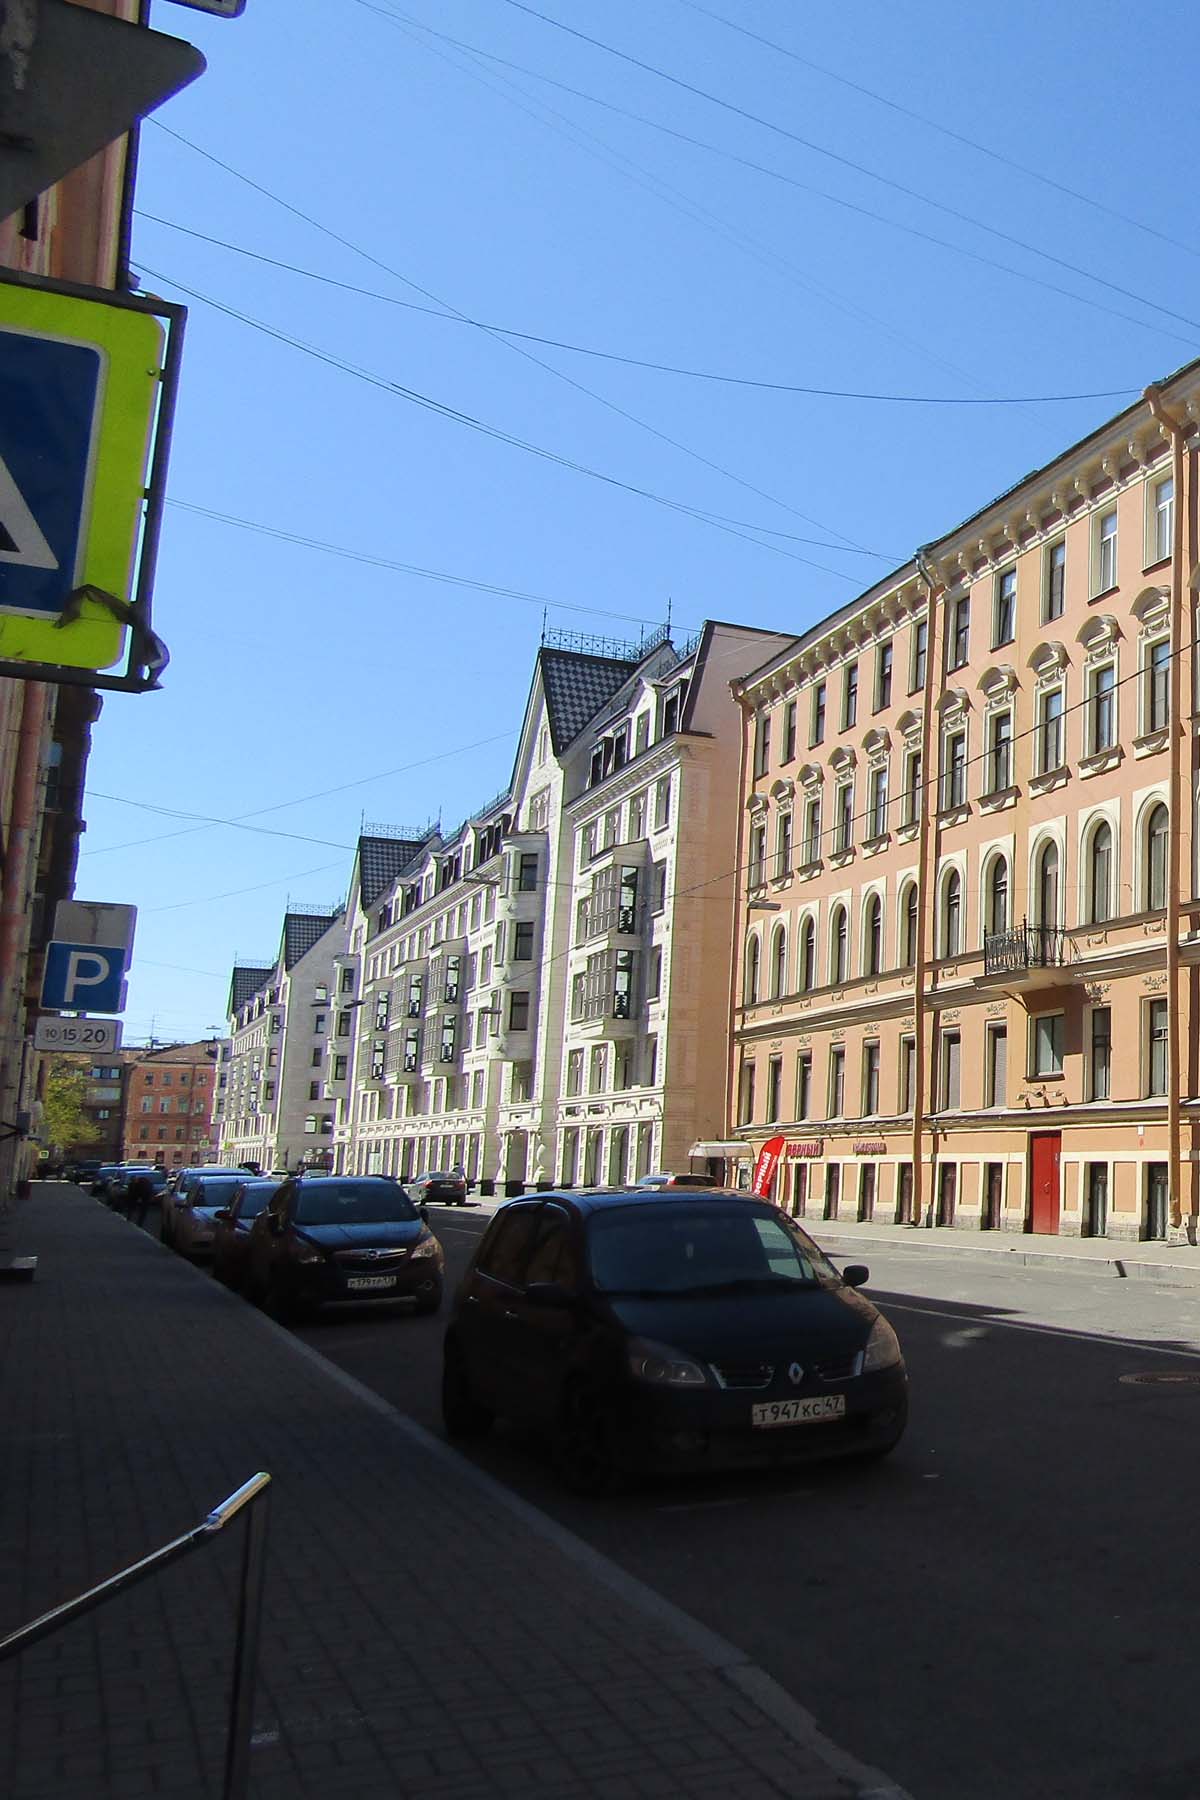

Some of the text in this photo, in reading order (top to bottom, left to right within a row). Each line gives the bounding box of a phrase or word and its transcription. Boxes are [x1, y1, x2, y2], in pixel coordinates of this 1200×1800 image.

[64, 951, 109, 1002] P
[46, 1028, 106, 1043] 10 15 20
